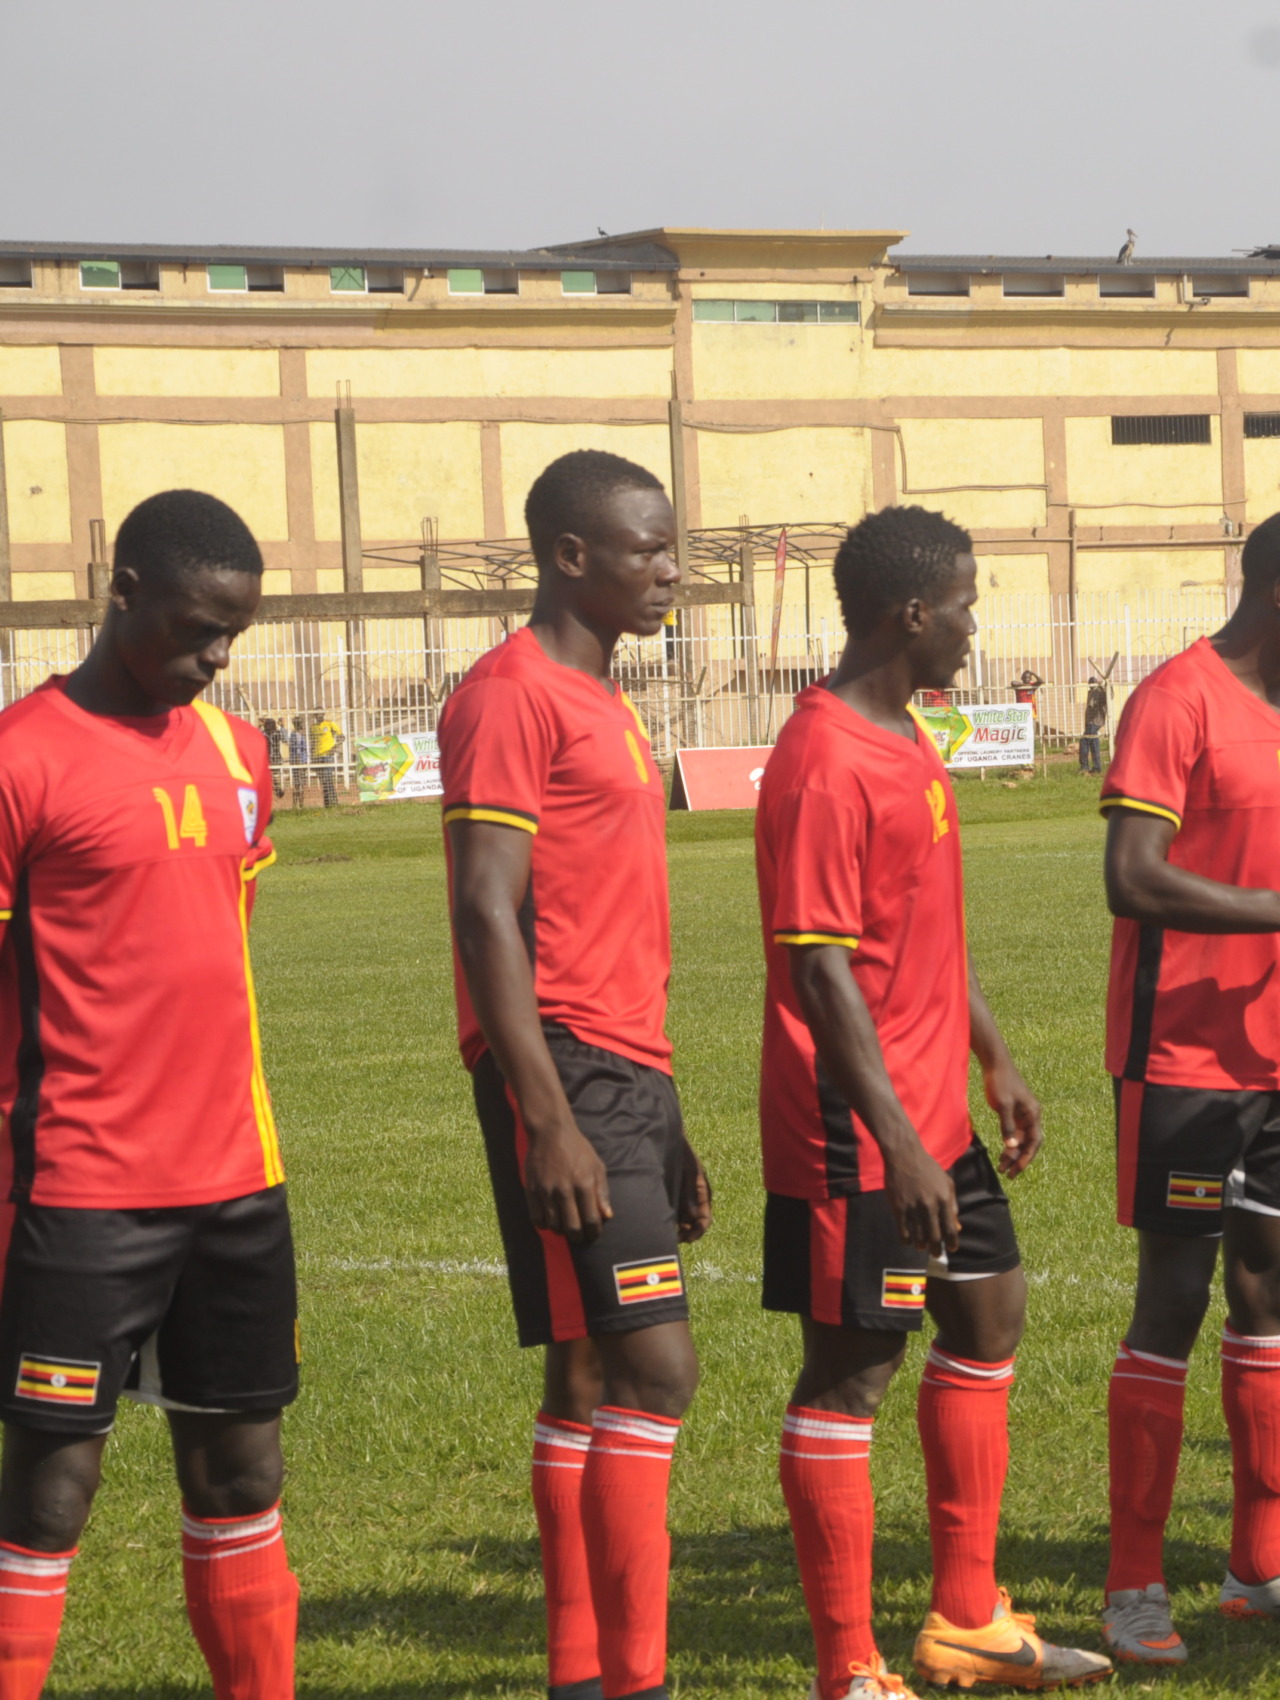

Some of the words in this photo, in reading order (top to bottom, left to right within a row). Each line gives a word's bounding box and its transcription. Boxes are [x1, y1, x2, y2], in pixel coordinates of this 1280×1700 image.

[973, 710, 1005, 724] White
[1006, 708, 1030, 723] Star
[974, 726, 1025, 743] Magic
[1001, 753, 1031, 761] CRANES
[152, 784, 207, 850] 14
